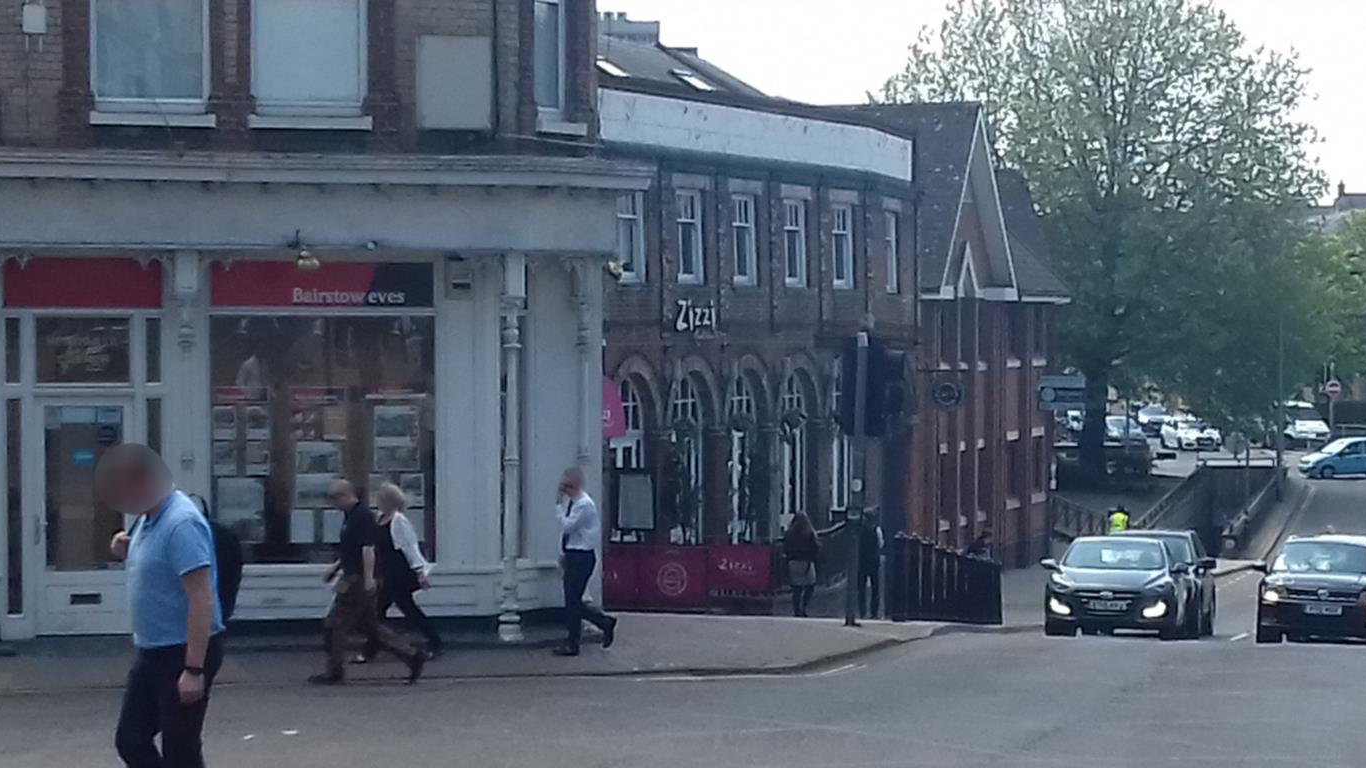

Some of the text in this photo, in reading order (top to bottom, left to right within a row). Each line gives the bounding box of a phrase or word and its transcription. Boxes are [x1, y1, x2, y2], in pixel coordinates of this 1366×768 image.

[292, 287, 406, 304] Bairstow eves
[676, 299, 716, 331] Zizzi
